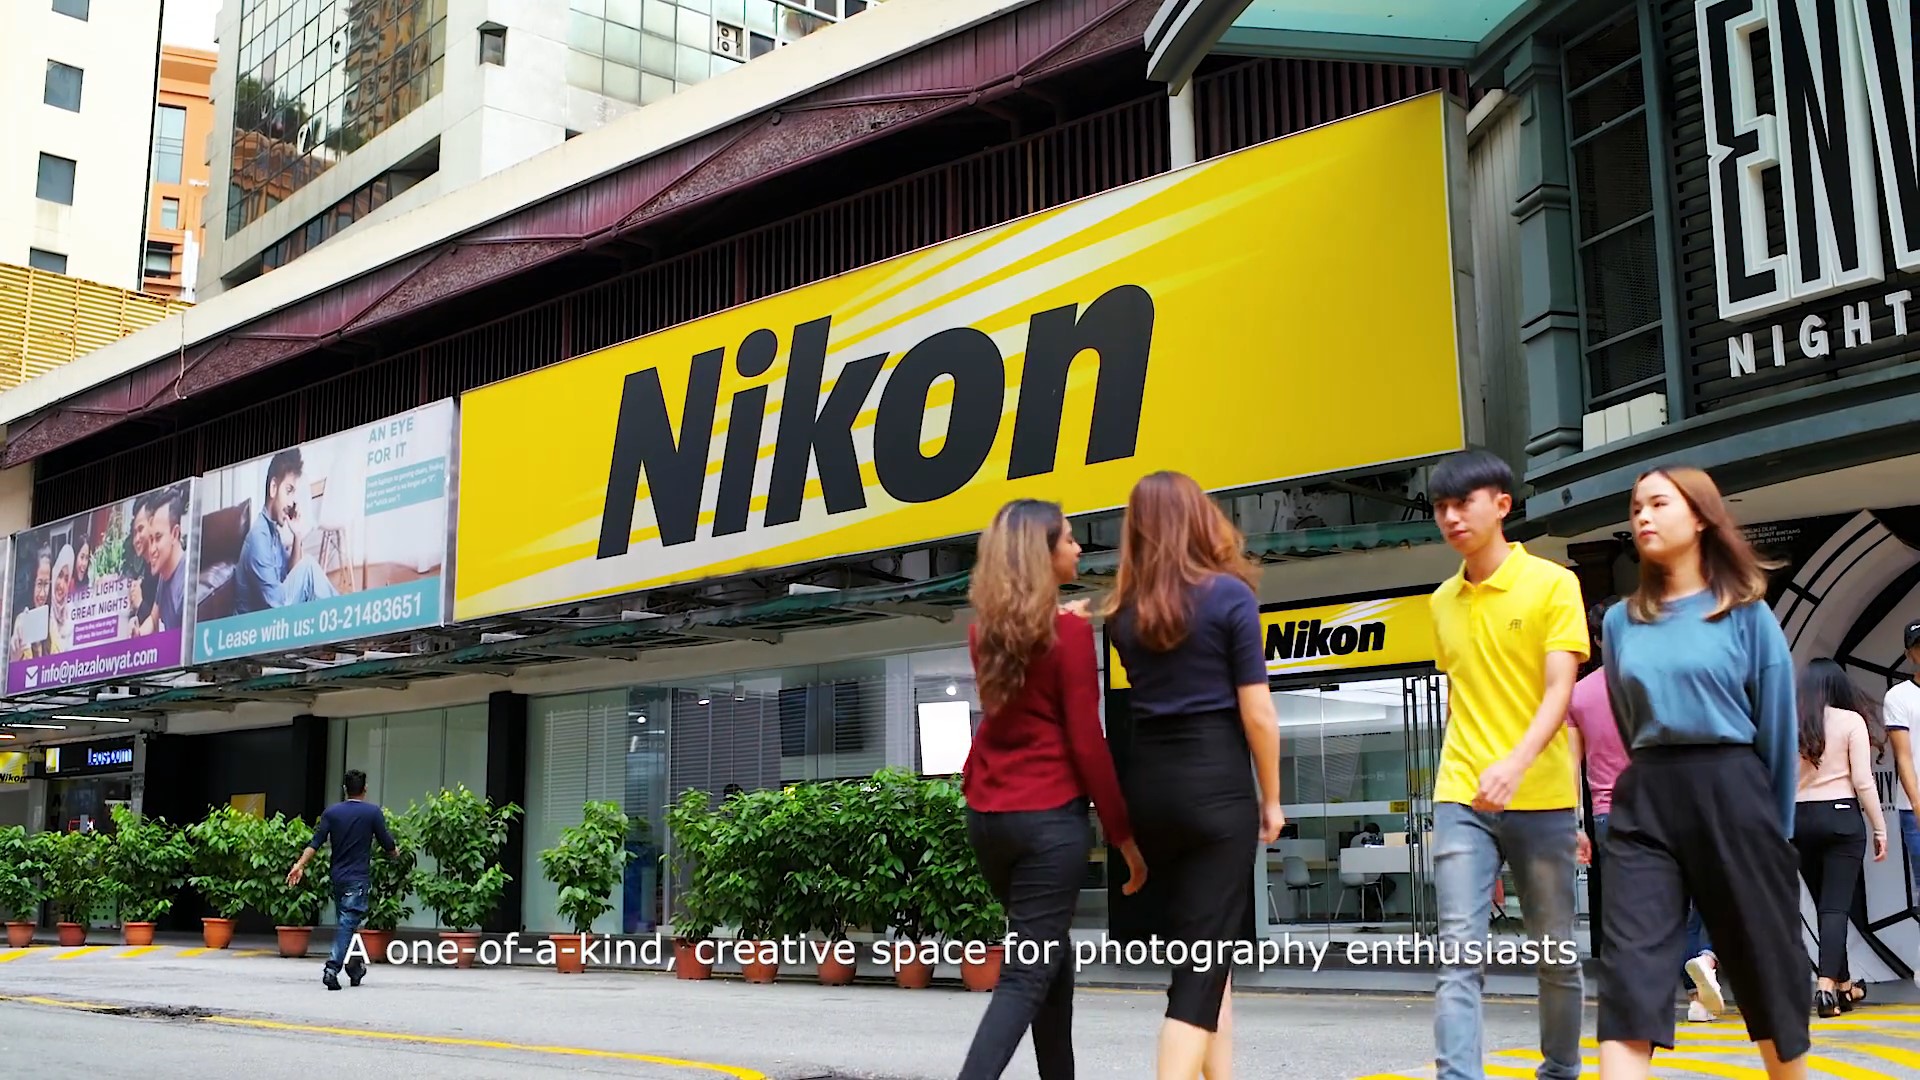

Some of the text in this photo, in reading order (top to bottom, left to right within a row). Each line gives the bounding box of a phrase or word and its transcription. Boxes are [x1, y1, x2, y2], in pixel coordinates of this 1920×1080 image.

[1728, 290, 1911, 377] NIGHT
[369, 416, 414, 443] AN EYE
[596, 284, 1154, 559] Nikon
[367, 442, 407, 466] FOR IT
[96, 580, 124, 596] LIGHTS
[71, 597, 128, 620] GREAT NIGHTS
[217, 592, 421, 650] Lease with us: 03-21483651
[1265, 619, 1386, 661] Nikon
[41, 648, 157, 683] info@plazalowyat.com
